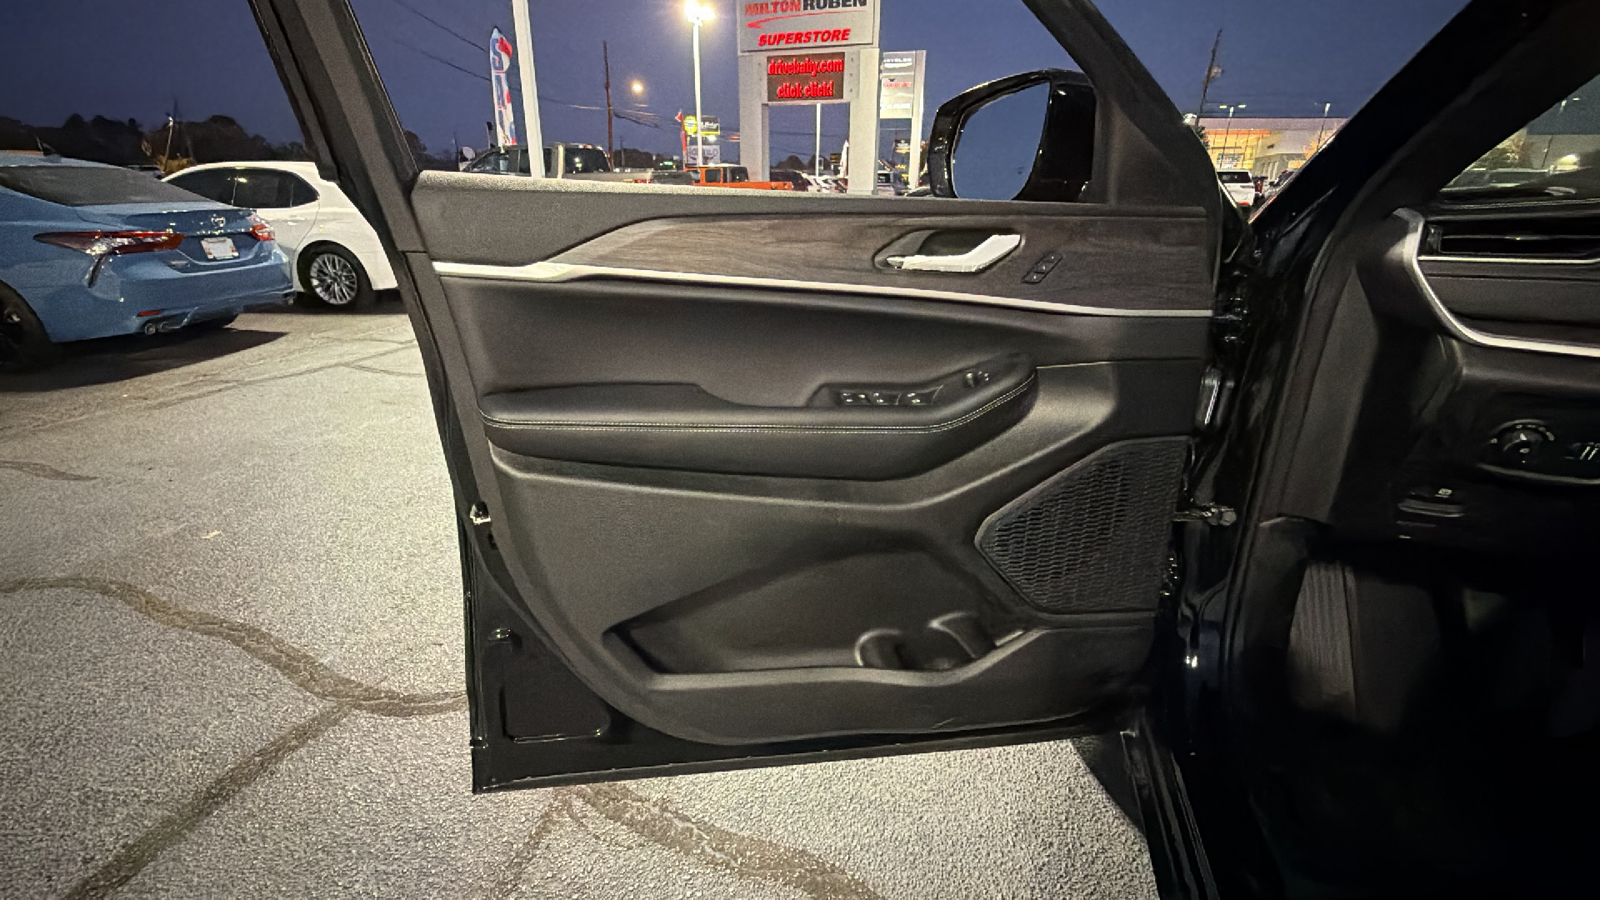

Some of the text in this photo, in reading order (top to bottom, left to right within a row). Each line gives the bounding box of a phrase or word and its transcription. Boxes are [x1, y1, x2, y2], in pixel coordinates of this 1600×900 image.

[745, 0, 867, 15] MILTON RUBEN
[757, 28, 851, 46] SUPERSTORE
[768, 58, 844, 76] drivebaby.com
[776, 81, 834, 98] click click!
